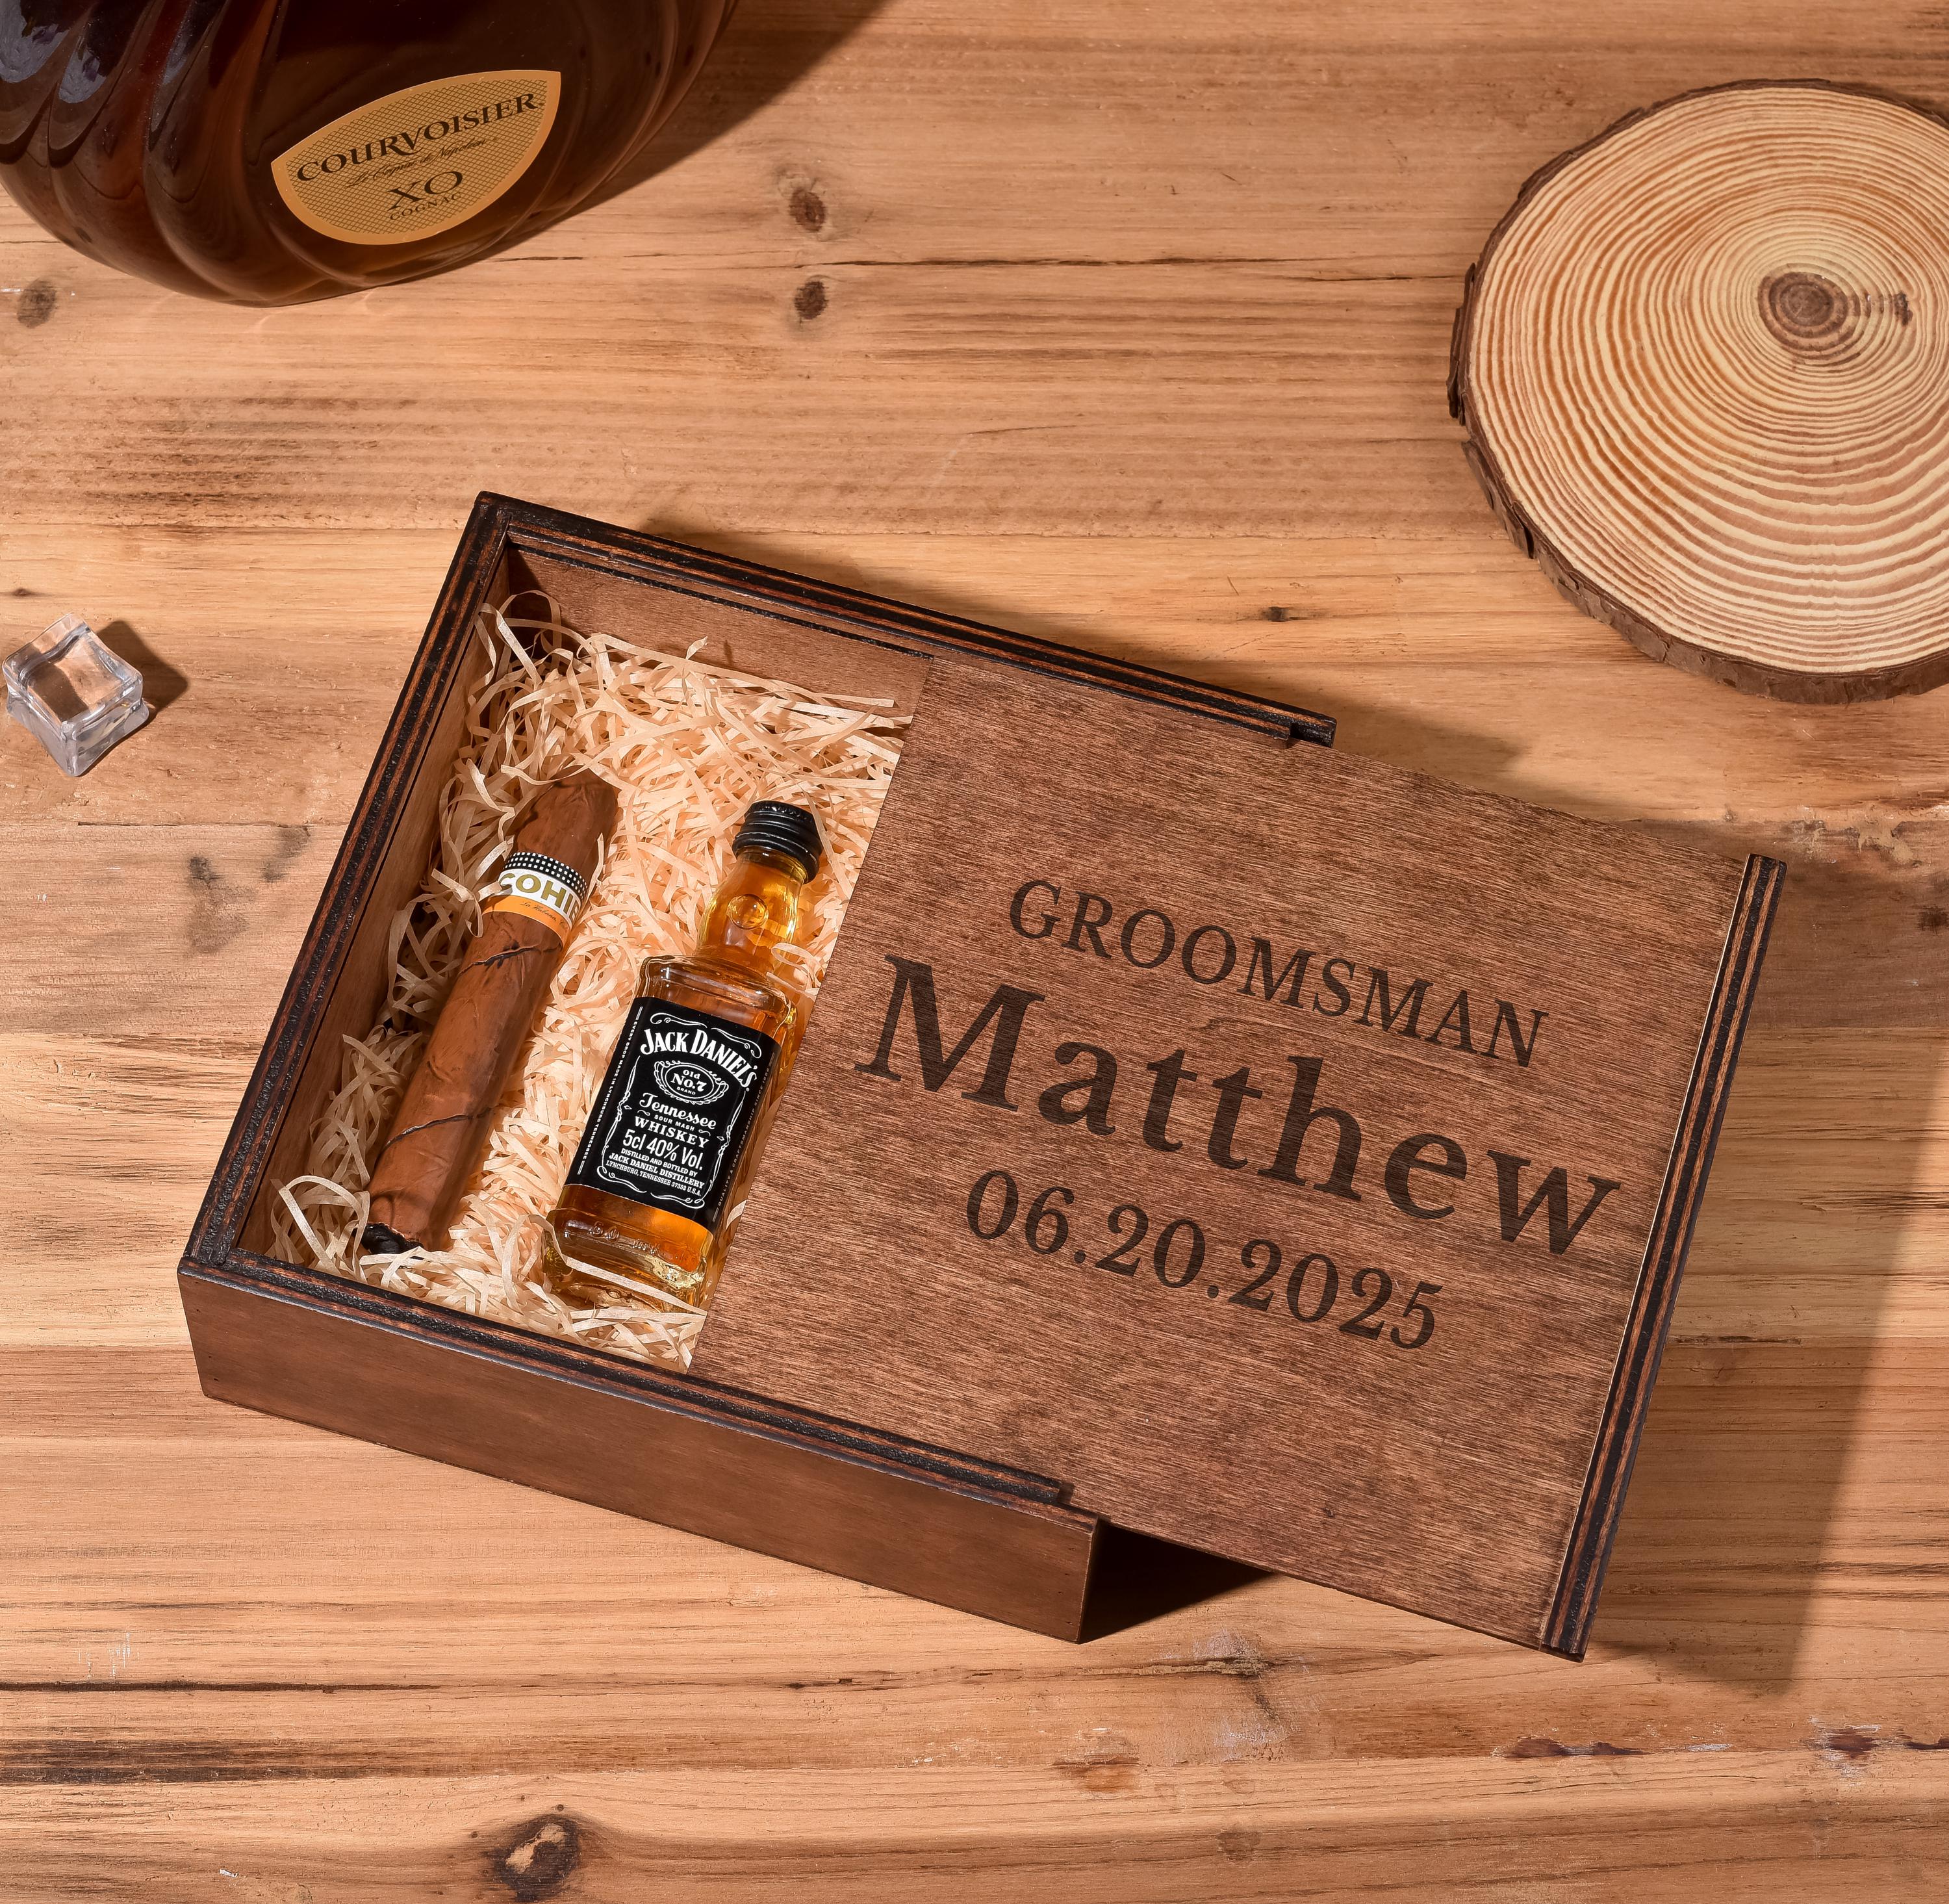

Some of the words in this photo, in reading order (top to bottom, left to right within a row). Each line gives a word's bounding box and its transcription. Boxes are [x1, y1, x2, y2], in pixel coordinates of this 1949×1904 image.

[297, 93, 539, 181] COURVOISIER
[386, 171, 463, 212] XO
[390, 192, 462, 220] COGNAC
[1010, 880, 1549, 1068] GROOMSMAN
[628, 1021, 637, 1041] EVERY
[614, 1060, 623, 1077] MADE
[640, 1029, 689, 1055] JACK
[690, 1029, 758, 1087] DANIEL'S
[683, 1069, 700, 1079] Old
[597, 1086, 613, 1122] LYNCHBURG
[677, 1087, 696, 1095] BRAND
[854, 954, 1621, 1255] Matthew
[639, 1092, 716, 1129] Tennessee
[654, 1114, 673, 1124] SOUR
[675, 1121, 694, 1131] MASH
[622, 1129, 646, 1150] 5cl
[646, 1137, 680, 1161] 40%
[681, 1146, 703, 1170] Vol.
[635, 1116, 709, 1148] WHISKEY
[718, 1175, 730, 1206] QUALITY
[754, 1085, 763, 1106] SINCE
[605, 1160, 639, 1176] LYNCHBURG,
[639, 1171, 672, 1186] TENNESSEE
[671, 1181, 686, 1191] 37352
[687, 1186, 702, 1197] U.S.A.
[609, 1152, 630, 1164] JACK
[630, 1159, 658, 1174] DANIEL
[659, 1168, 705, 1189] DISTILLERY
[621, 1148, 650, 1161] DISTILLED
[650, 1157, 662, 1166] AND
[663, 1162, 689, 1174] BOTTLED
[966, 1170, 1444, 1350] 06.20.2025
